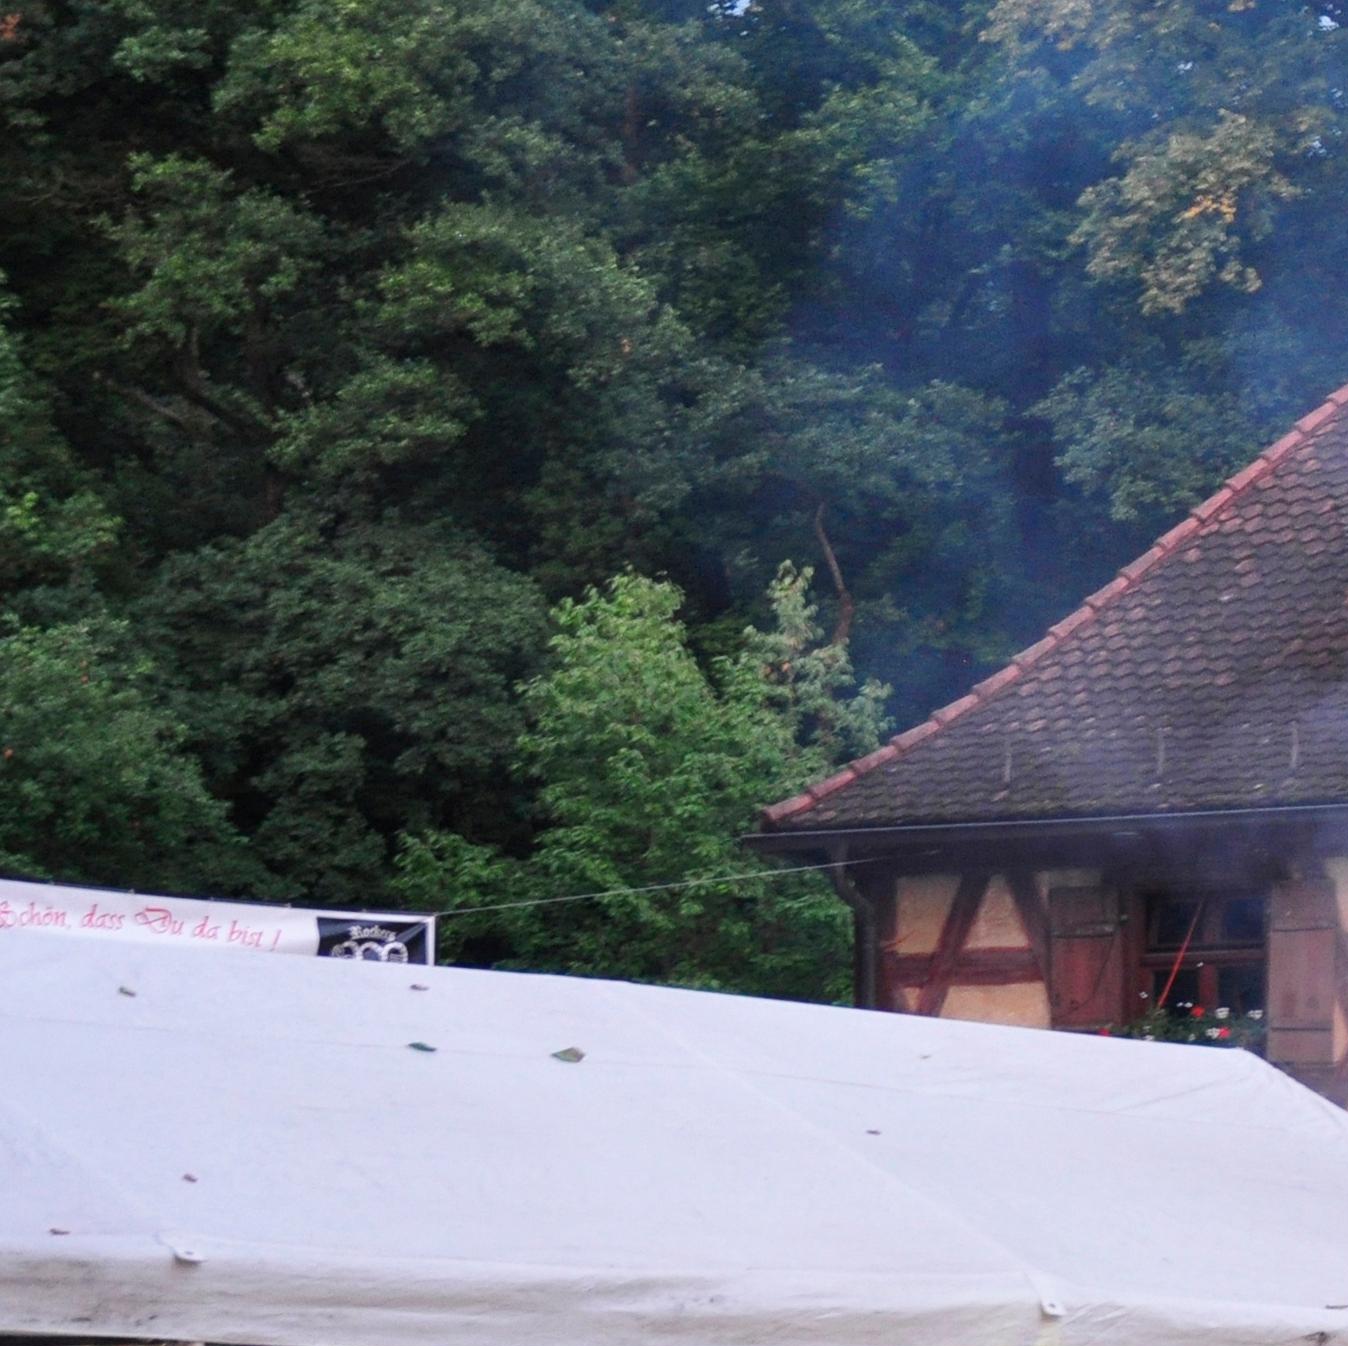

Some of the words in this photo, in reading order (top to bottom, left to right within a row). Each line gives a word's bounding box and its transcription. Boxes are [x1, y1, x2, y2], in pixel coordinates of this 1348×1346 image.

[80, 903, 125, 930] dass
[192, 915, 221, 939] da
[227, 920, 263, 948] bist
